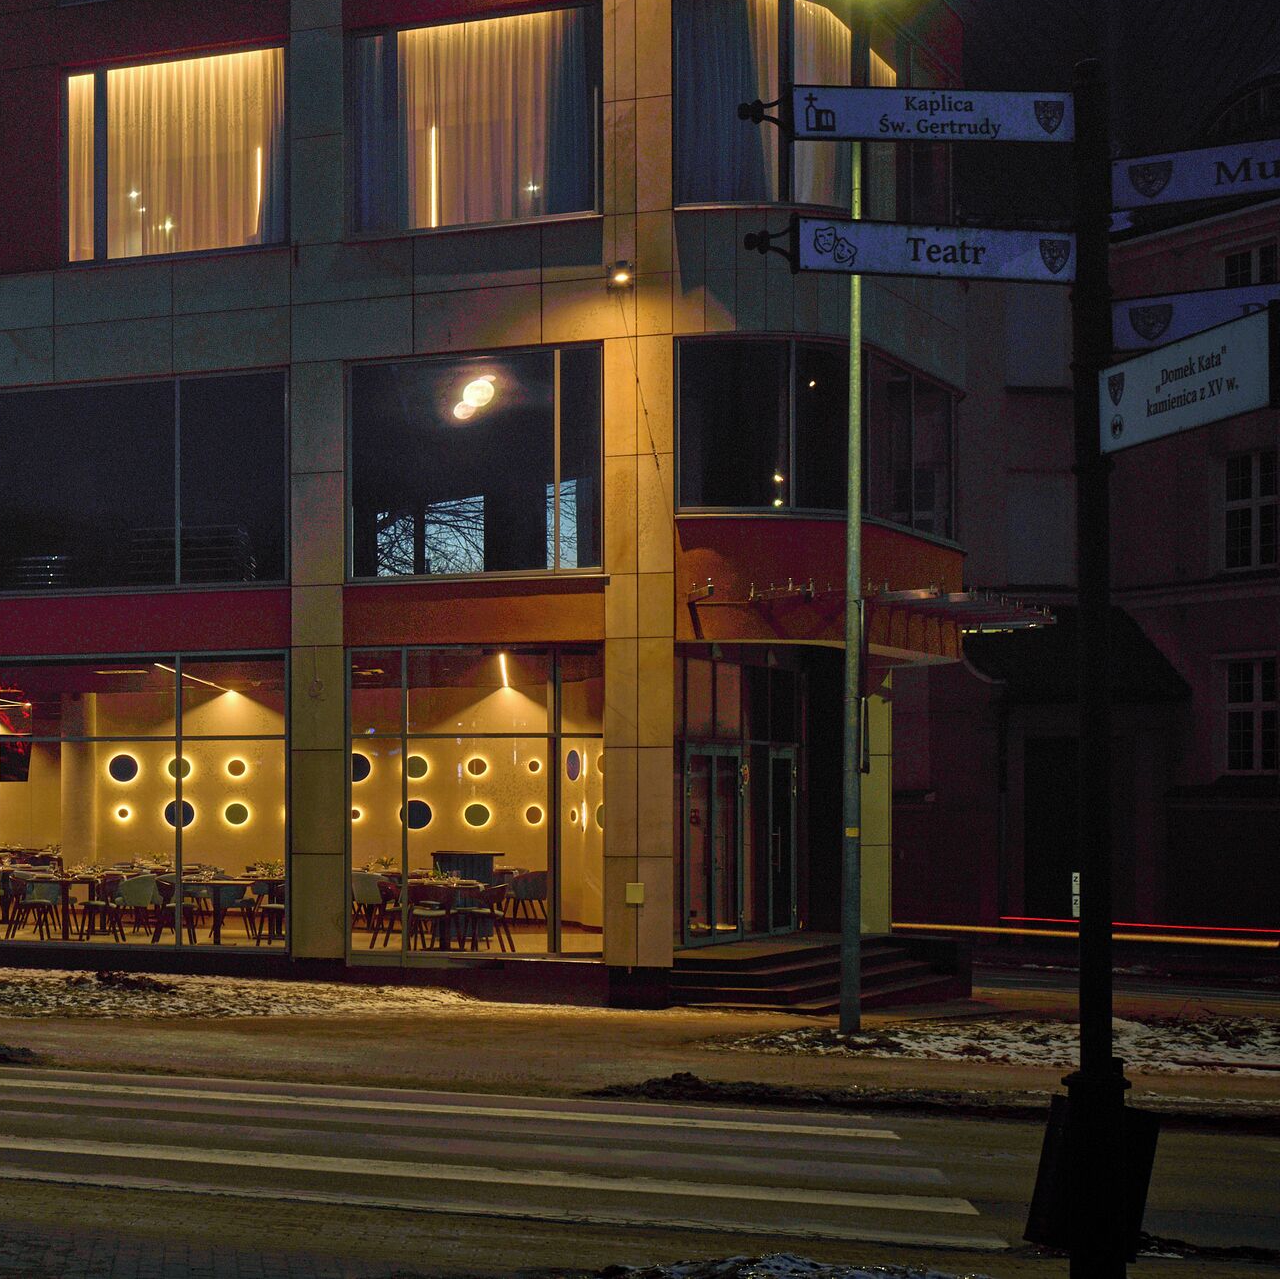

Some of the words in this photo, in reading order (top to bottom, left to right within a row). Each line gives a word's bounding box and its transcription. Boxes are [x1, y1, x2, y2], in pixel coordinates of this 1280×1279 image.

[904, 95, 974, 116] Kaplica
[879, 114, 911, 133] Św.
[916, 118, 1002, 139] Gertrudy
[906, 237, 986, 265] Teatr
[1146, 388, 1197, 417] kamienica
[1199, 386, 1206, 401] z
[1207, 378, 1224, 399] XV
[1226, 377, 1239, 392] w.
